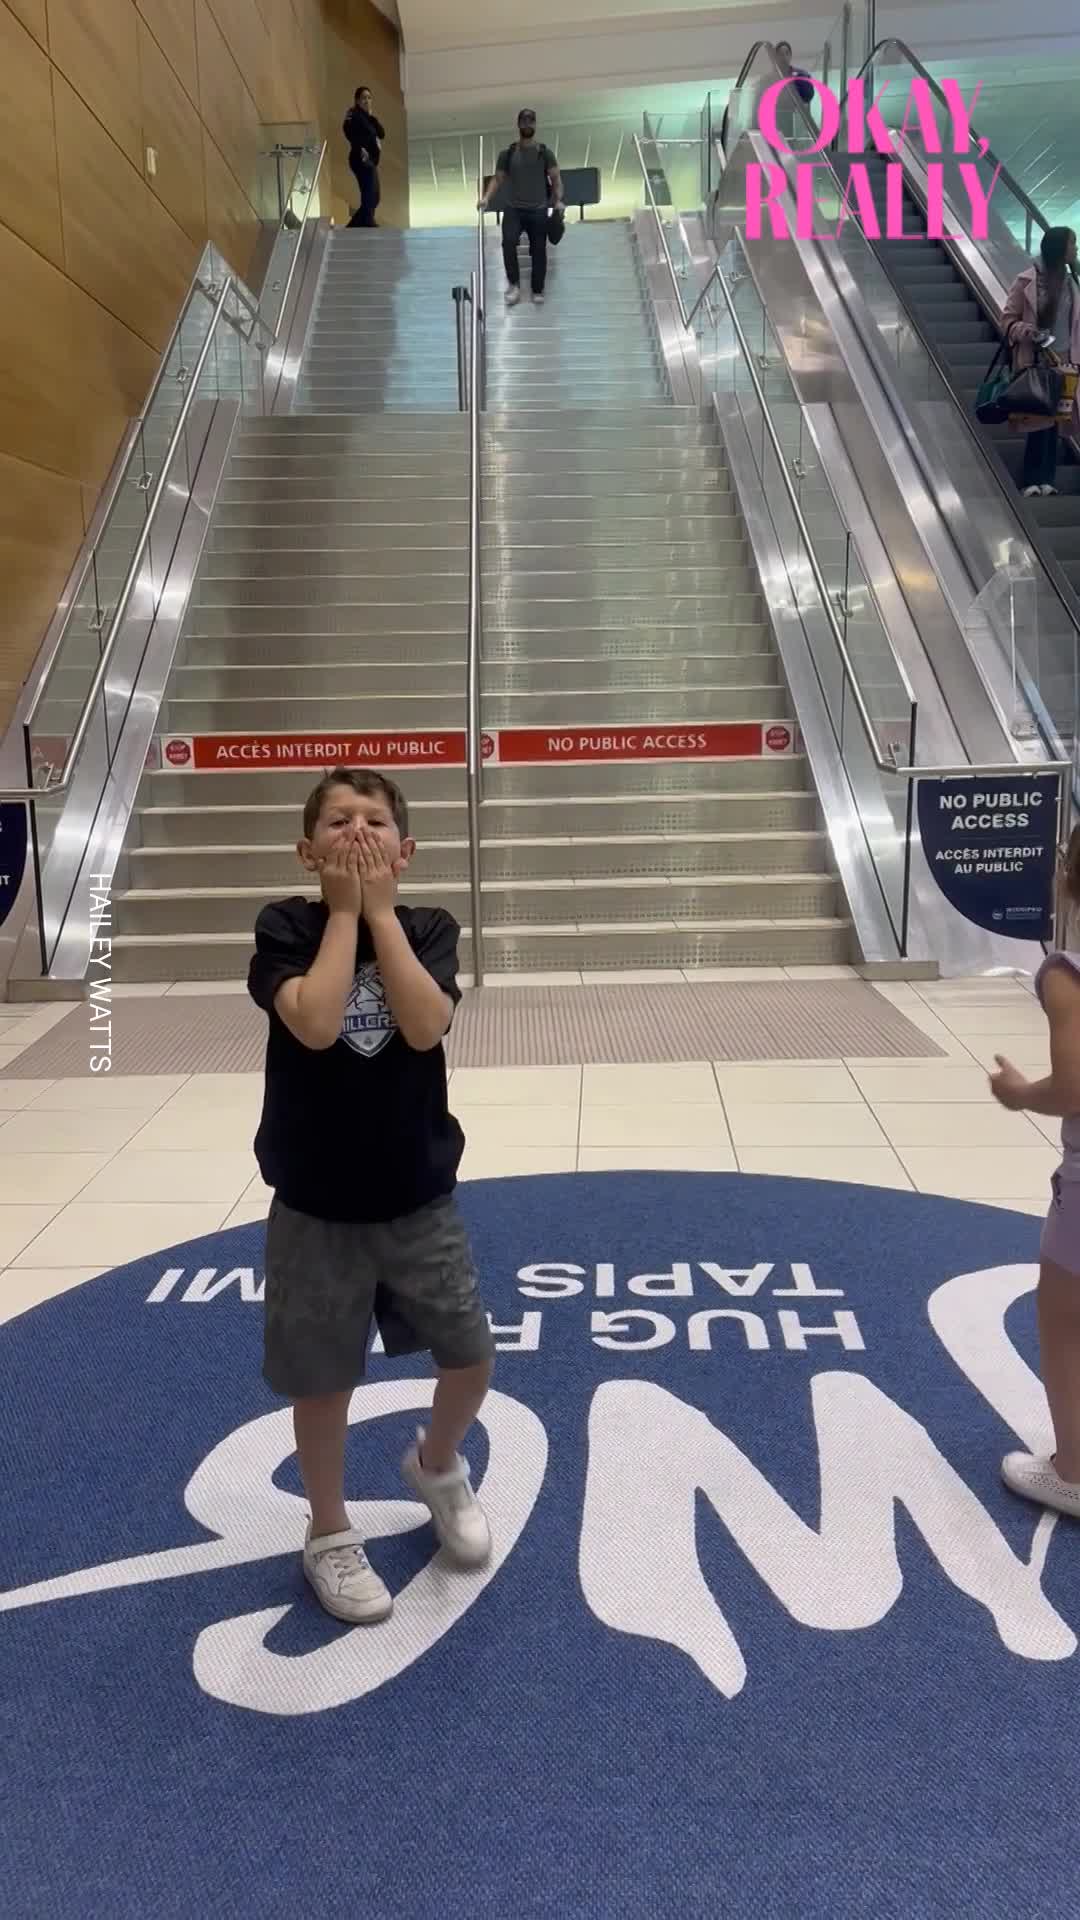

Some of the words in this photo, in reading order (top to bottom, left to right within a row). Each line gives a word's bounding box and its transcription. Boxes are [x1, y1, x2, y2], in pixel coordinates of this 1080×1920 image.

[216, 740, 271, 759] ACCÈS
[277, 742, 352, 758] INTERDIT
[358, 742, 380, 757] AU
[387, 740, 447, 756] PUBLIC
[548, 737, 573, 752] NO
[580, 735, 637, 751] PUBLIC
[642, 734, 708, 749] ACCESS
[939, 795, 967, 809] NO
[973, 791, 1043, 808] PUBLIC
[951, 813, 1030, 830] ACCESS
[983, 847, 1044, 859] INTERDIT
[954, 863, 972, 874] AU
[976, 861, 1024, 873] PUBLIC
[517, 1263, 845, 1298] TAPIS
[590, 1309, 866, 1351] HUG
